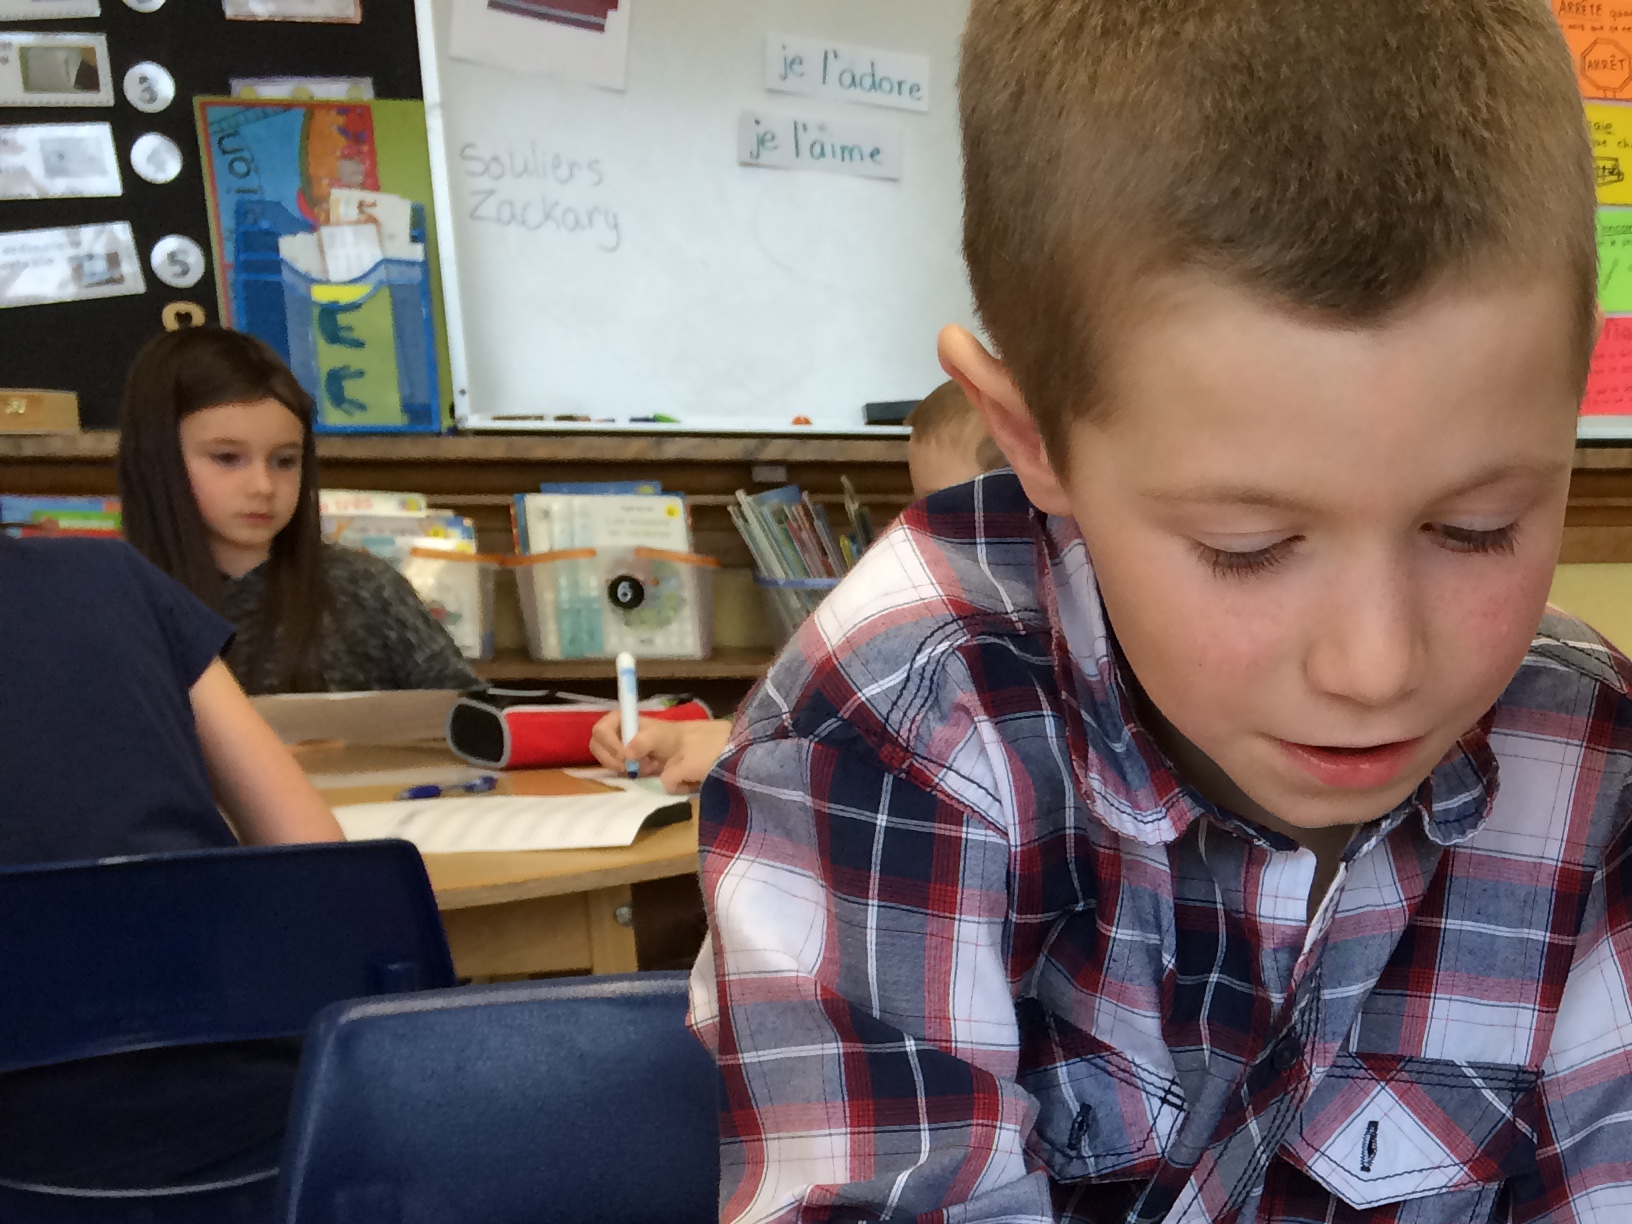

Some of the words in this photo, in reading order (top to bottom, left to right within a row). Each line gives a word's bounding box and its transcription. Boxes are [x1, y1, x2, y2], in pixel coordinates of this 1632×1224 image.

[779, 45, 804, 81] je
[822, 49, 922, 101] l'adore
[1587, 53, 1626, 71] ARRÊT
[459, 139, 604, 187] Souliers
[749, 119, 779, 160] je
[791, 120, 883, 166] l'aime
[469, 189, 621, 253] Zackary
[617, 581, 634, 603] 6
